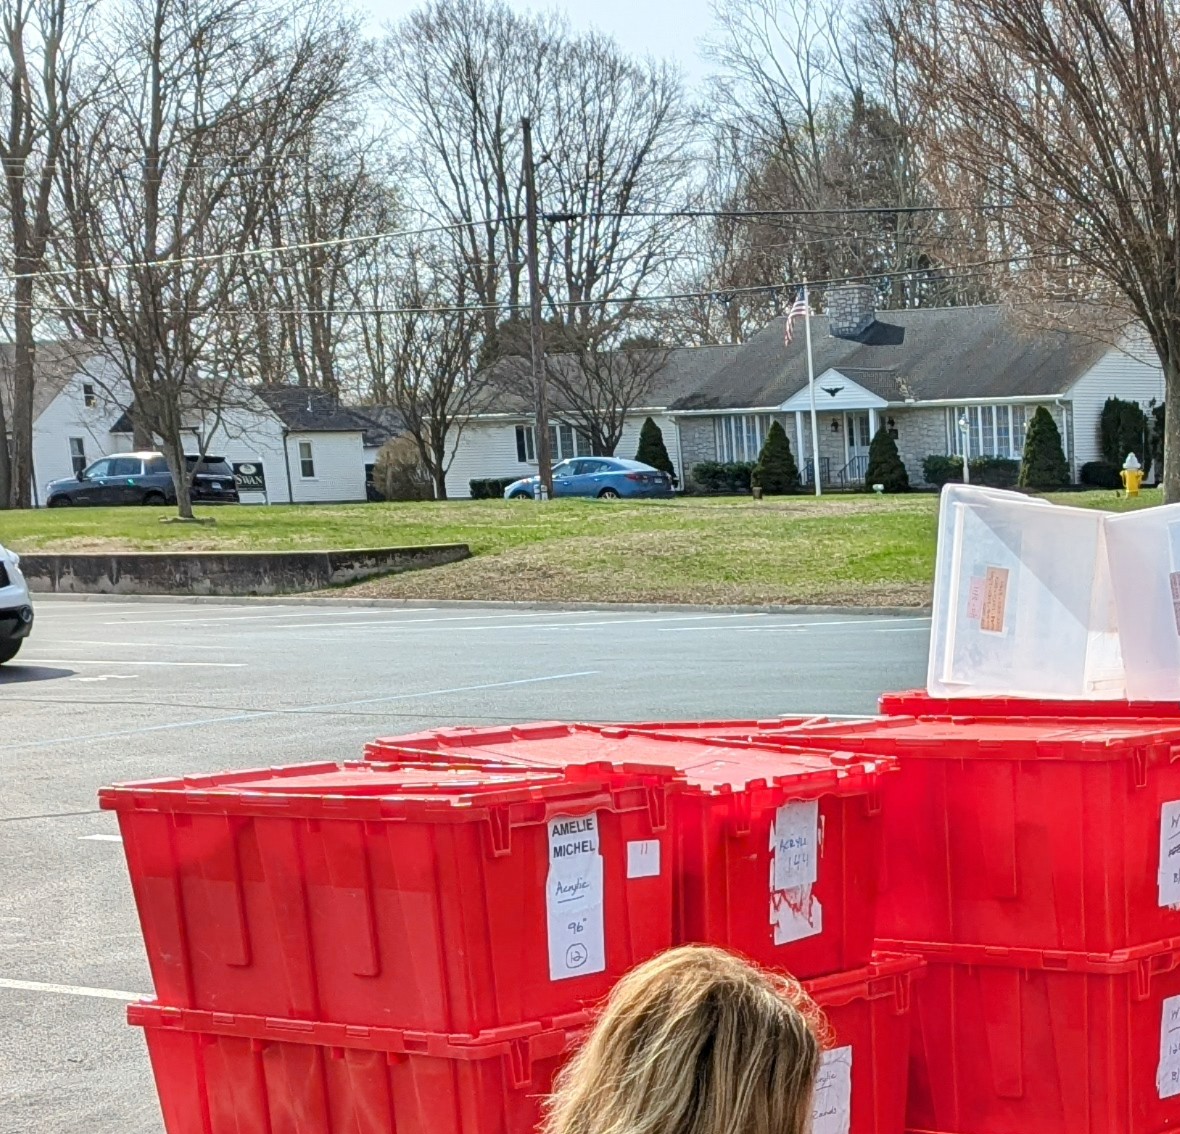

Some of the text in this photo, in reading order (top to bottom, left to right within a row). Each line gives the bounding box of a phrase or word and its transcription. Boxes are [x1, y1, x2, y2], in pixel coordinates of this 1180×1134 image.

[237, 474, 263, 485] SWAN
[552, 818, 594, 838] AMELIE
[553, 840, 595, 859] MICHEL
